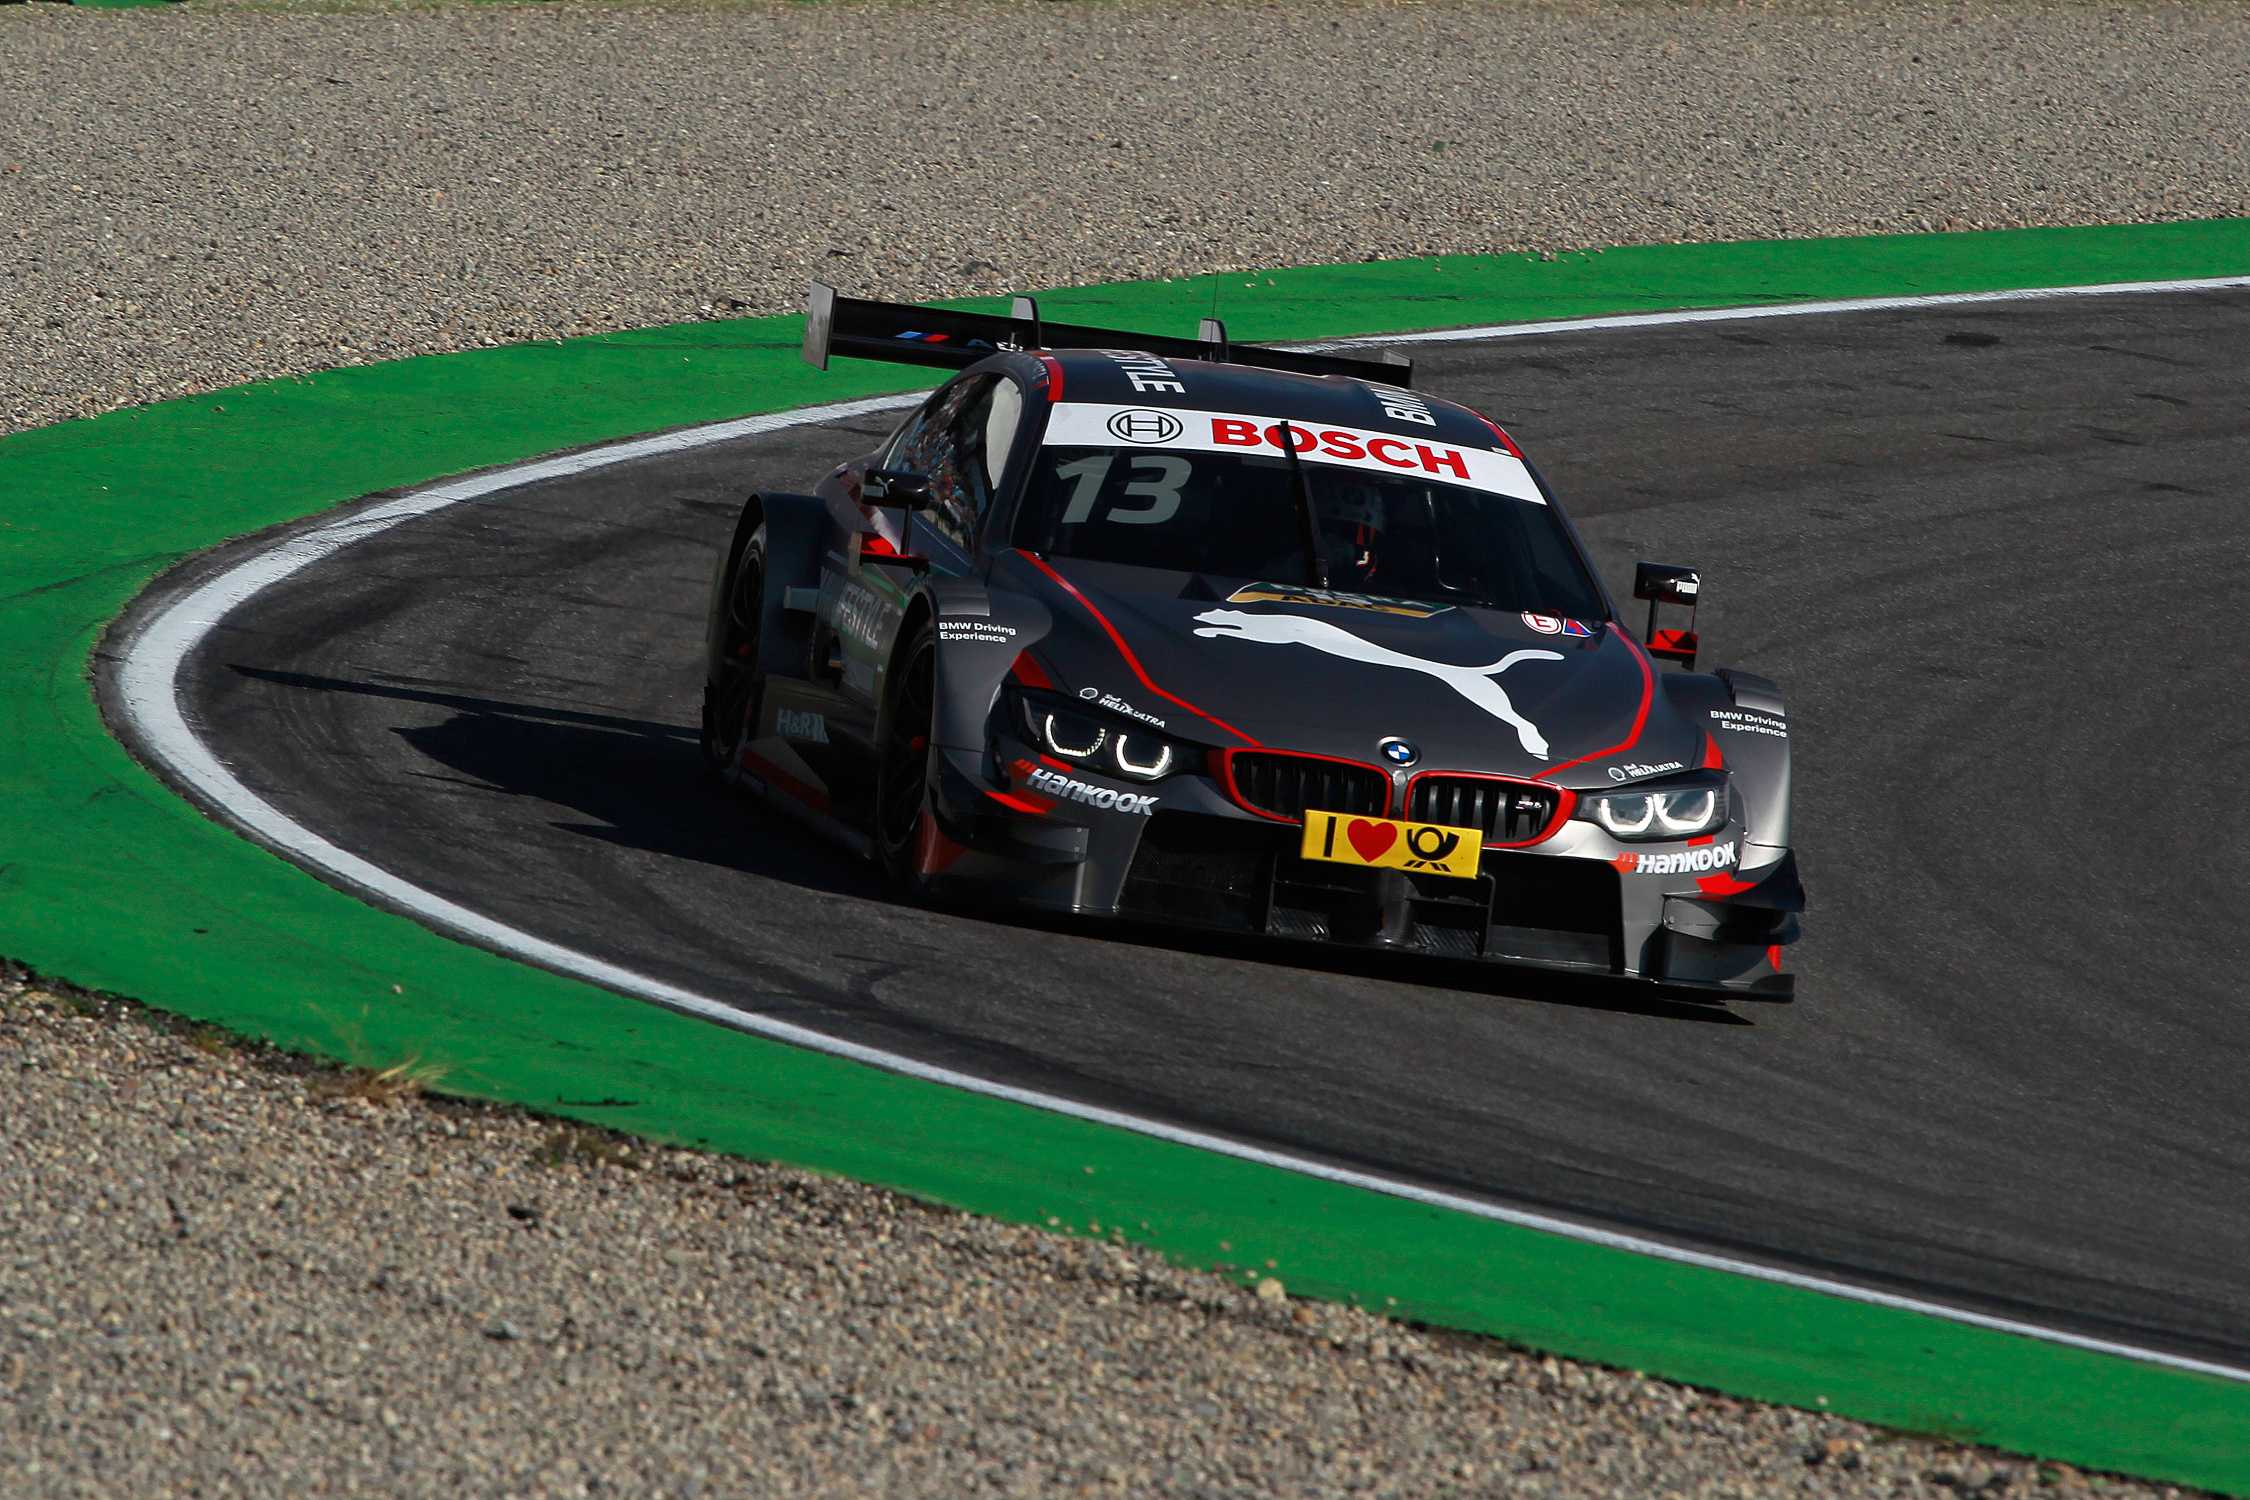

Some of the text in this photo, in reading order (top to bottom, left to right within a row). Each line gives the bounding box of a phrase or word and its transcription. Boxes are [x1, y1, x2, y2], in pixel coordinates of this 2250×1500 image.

[1211, 418, 1471, 480] BOSCH
[1056, 455, 1192, 524] 13
[938, 622, 1017, 636] BMW Driving
[940, 631, 1007, 643] Experience
[1710, 710, 1787, 730] BMW Driving
[1721, 720, 1787, 738] Experience
